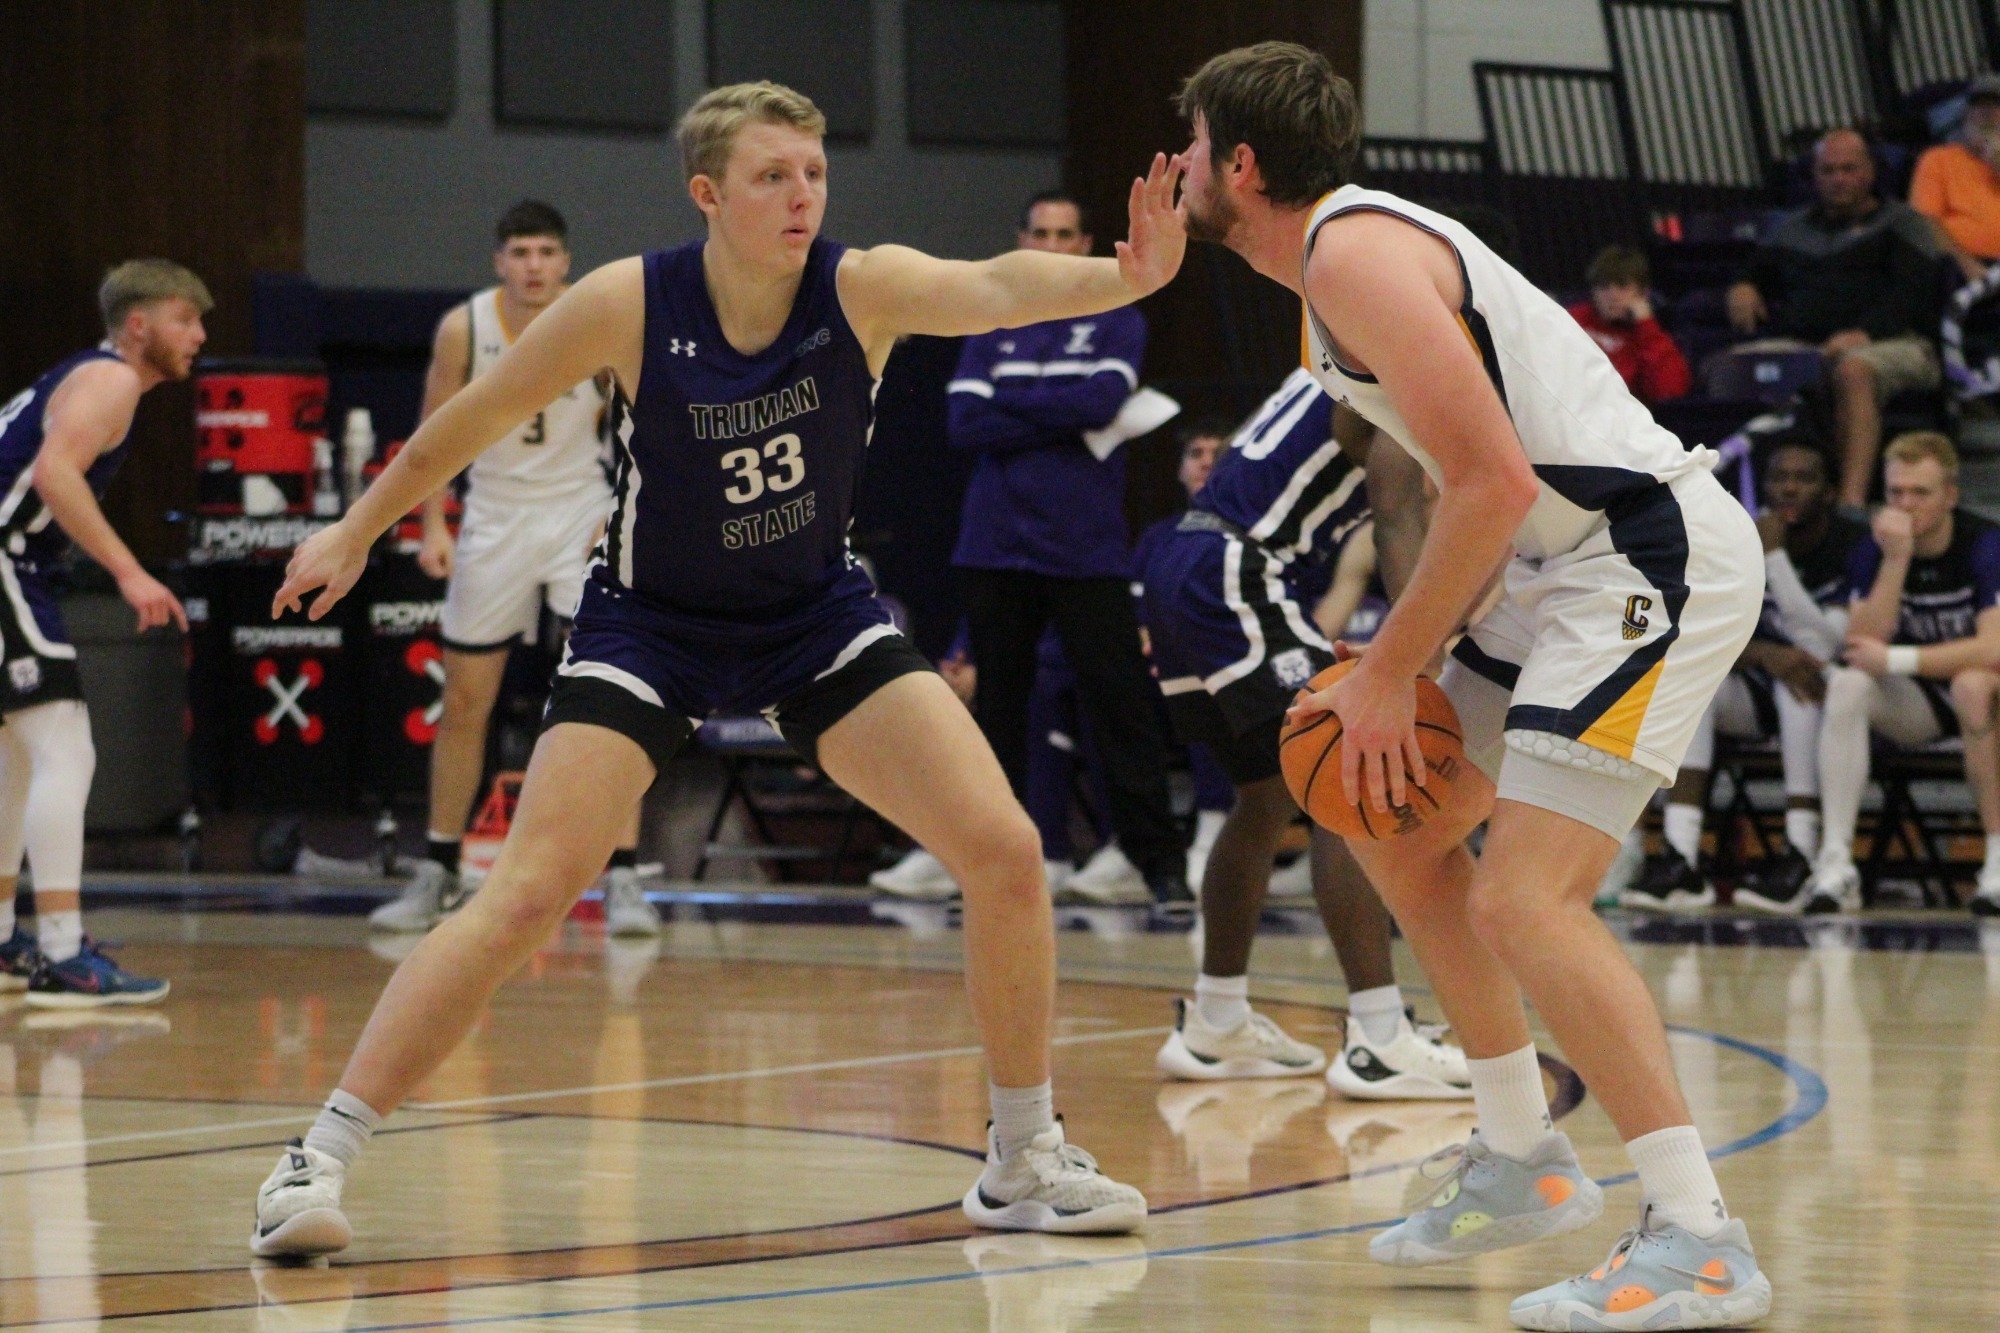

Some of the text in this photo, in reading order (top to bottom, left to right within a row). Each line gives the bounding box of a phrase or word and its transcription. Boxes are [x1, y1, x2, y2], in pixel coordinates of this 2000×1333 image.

[522, 411, 545, 445] 3
[689, 376, 819, 440] TRUMAN
[721, 433, 806, 504] 33
[722, 491, 815, 549] STATE
[1625, 595, 1652, 628] C
